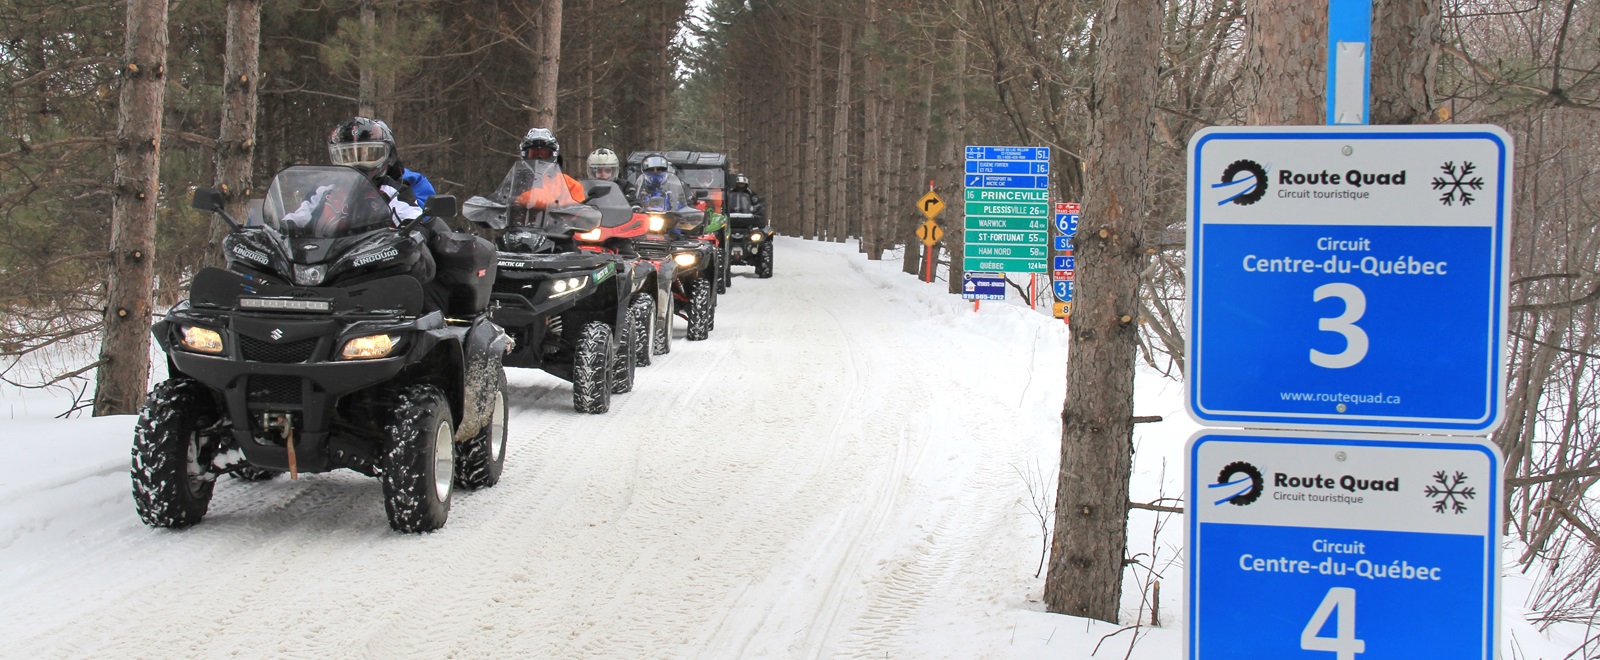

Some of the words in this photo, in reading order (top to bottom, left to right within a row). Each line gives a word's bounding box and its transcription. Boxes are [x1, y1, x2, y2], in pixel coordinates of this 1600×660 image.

[1037, 164, 1044, 172] 16
[1278, 169, 1341, 185] Route
[1345, 170, 1405, 188] Quad
[981, 192, 1048, 200] PRINCEVILLE
[1278, 189, 1310, 199] Circuit
[1313, 189, 1369, 200] touristique
[1060, 216, 1078, 230] 65
[1029, 234, 1038, 242] 55
[1316, 237, 1370, 251] Circuit
[980, 261, 1004, 269] QUÉBEC
[1242, 254, 1447, 277] Centre-du-Québec
[1309, 282, 1369, 369] 3
[1280, 390, 1400, 405] www.routequad.ca
[1274, 472, 1335, 489] Route
[1340, 475, 1399, 492] Quad
[1273, 491, 1305, 502] Circuit
[1308, 492, 1363, 505] touristique
[1312, 539, 1365, 554] Circuit
[1239, 554, 1441, 581] Centre-du-Québec
[1300, 587, 1365, 660] 4
